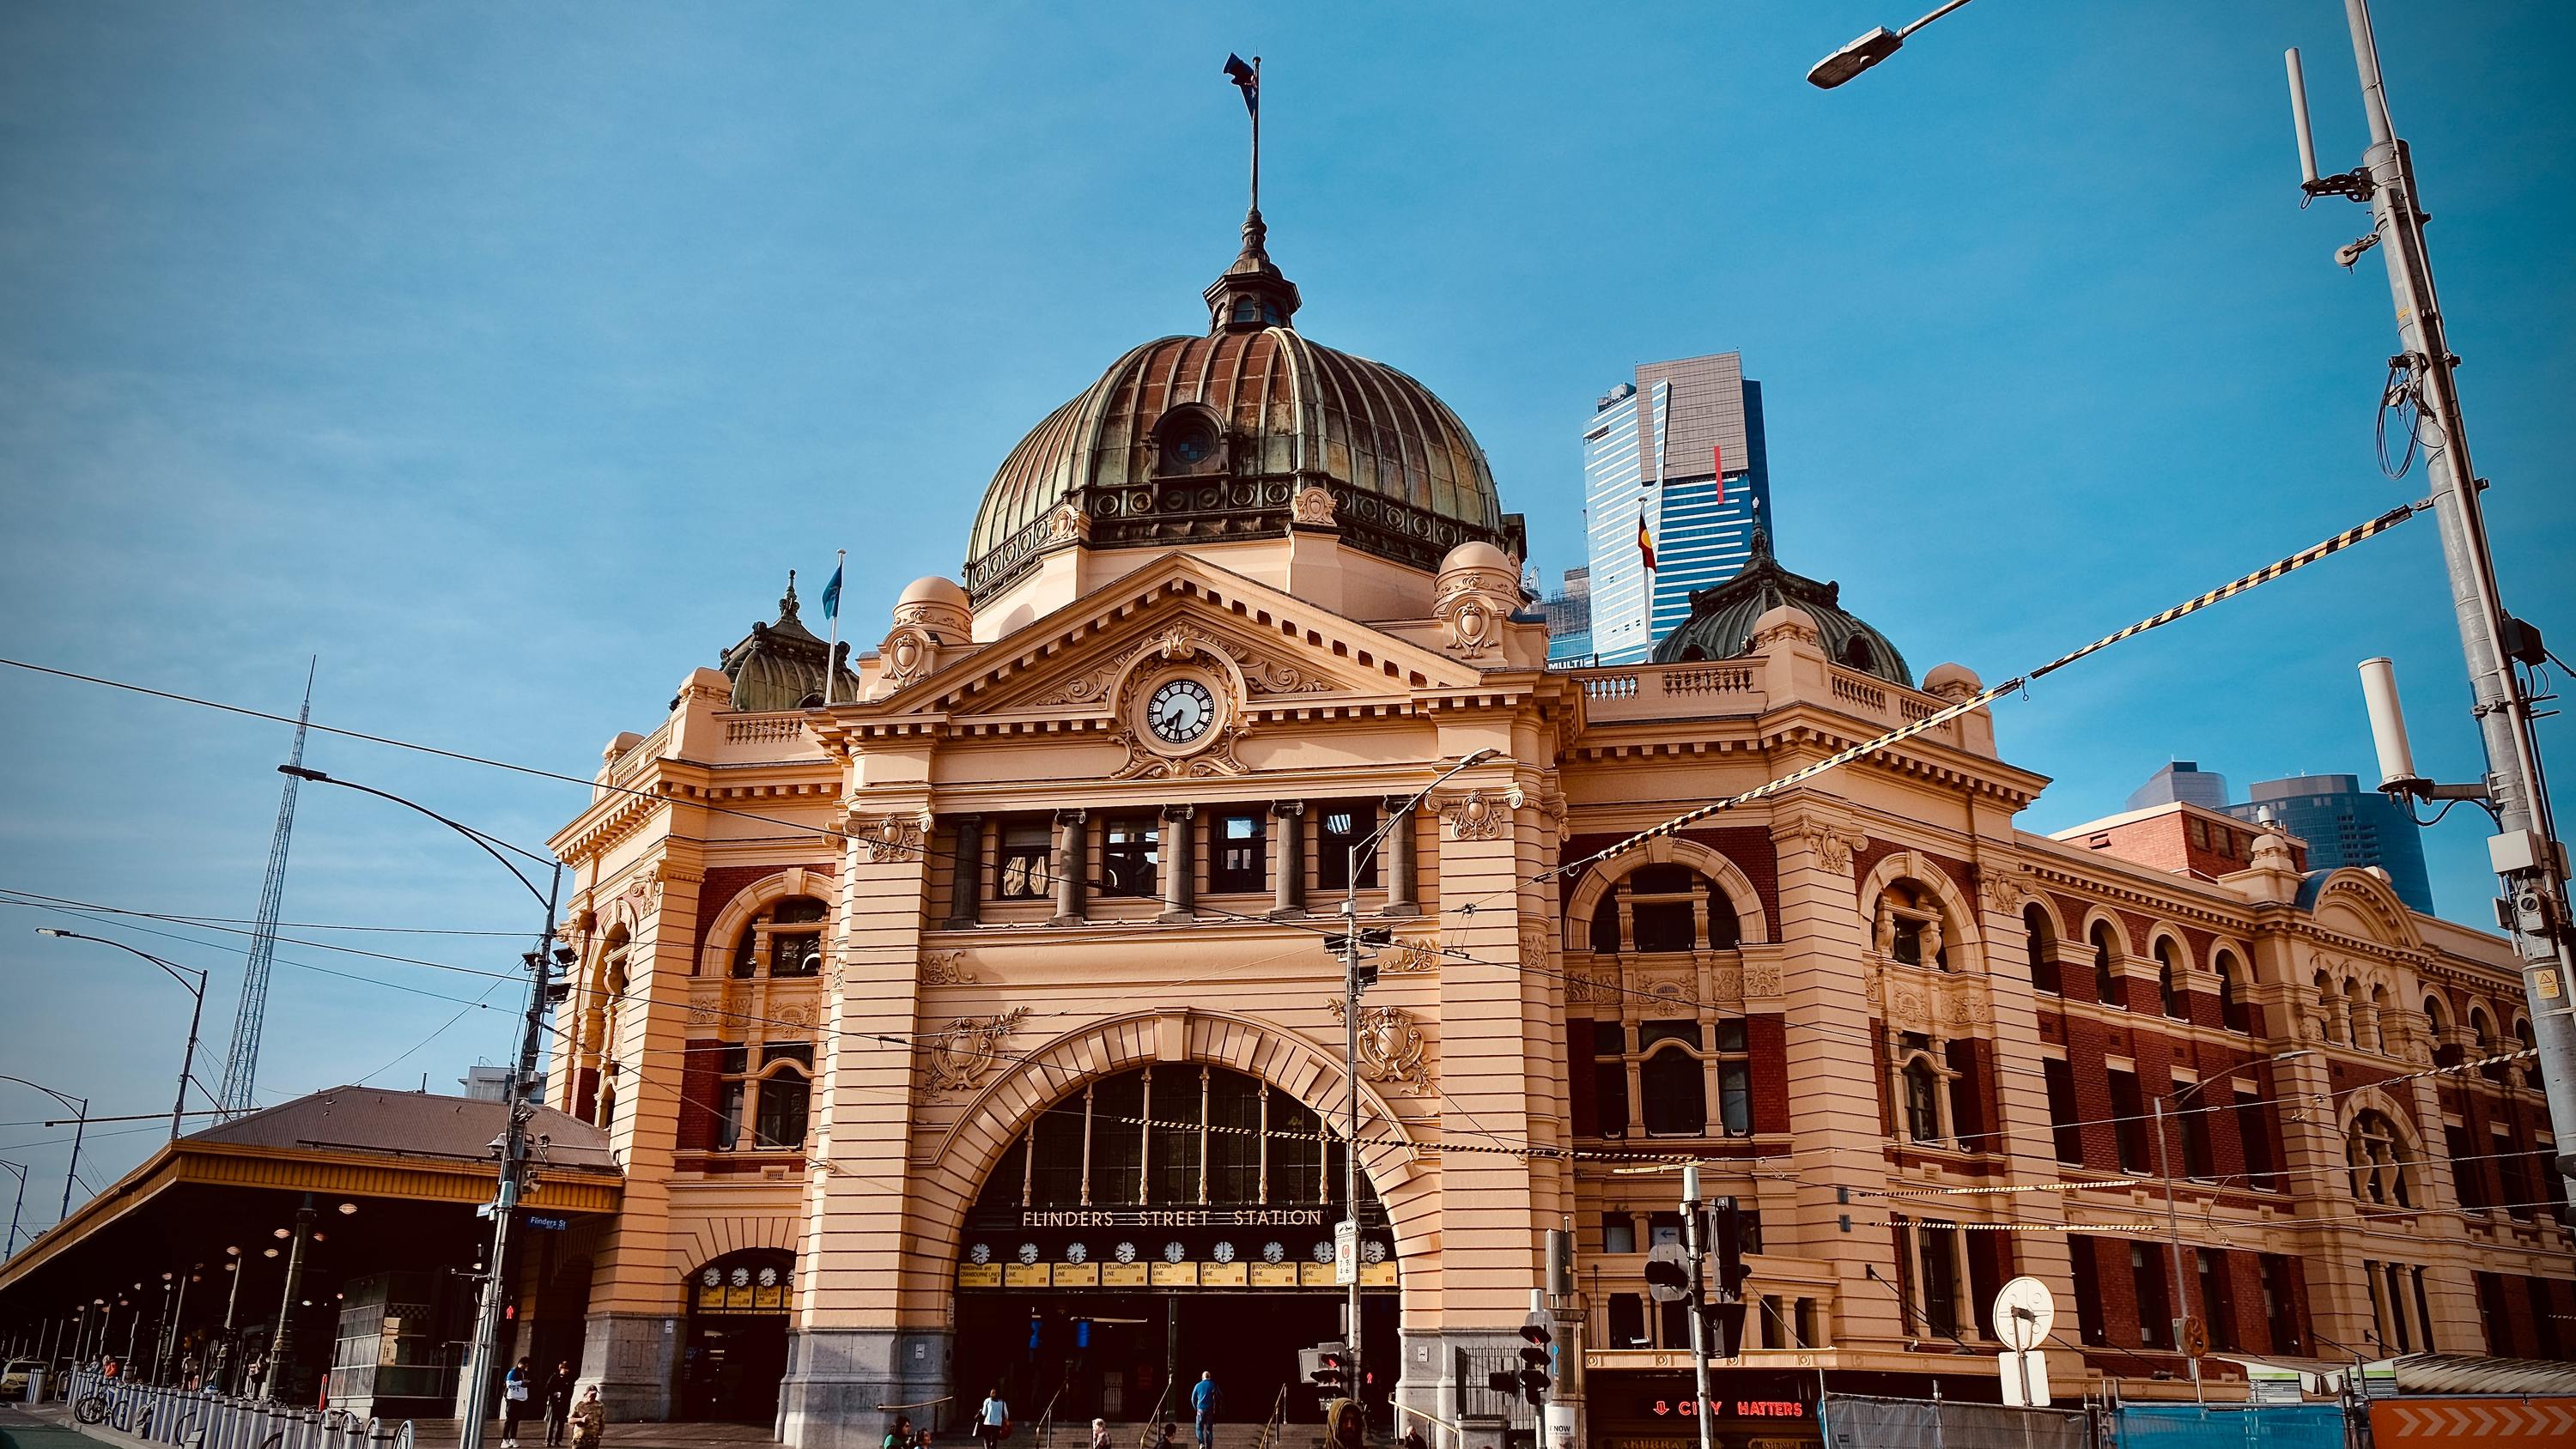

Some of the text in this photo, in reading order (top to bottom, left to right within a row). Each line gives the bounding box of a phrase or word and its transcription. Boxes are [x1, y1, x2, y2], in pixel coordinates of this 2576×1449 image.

[531, 1216, 556, 1226] Flinders
[1022, 1210, 1321, 1227] FLINDERS STREET STATION
[1679, 1401, 1802, 1416] CIY HATTERS
[1621, 1440, 1680, 1449] AKUBRA
